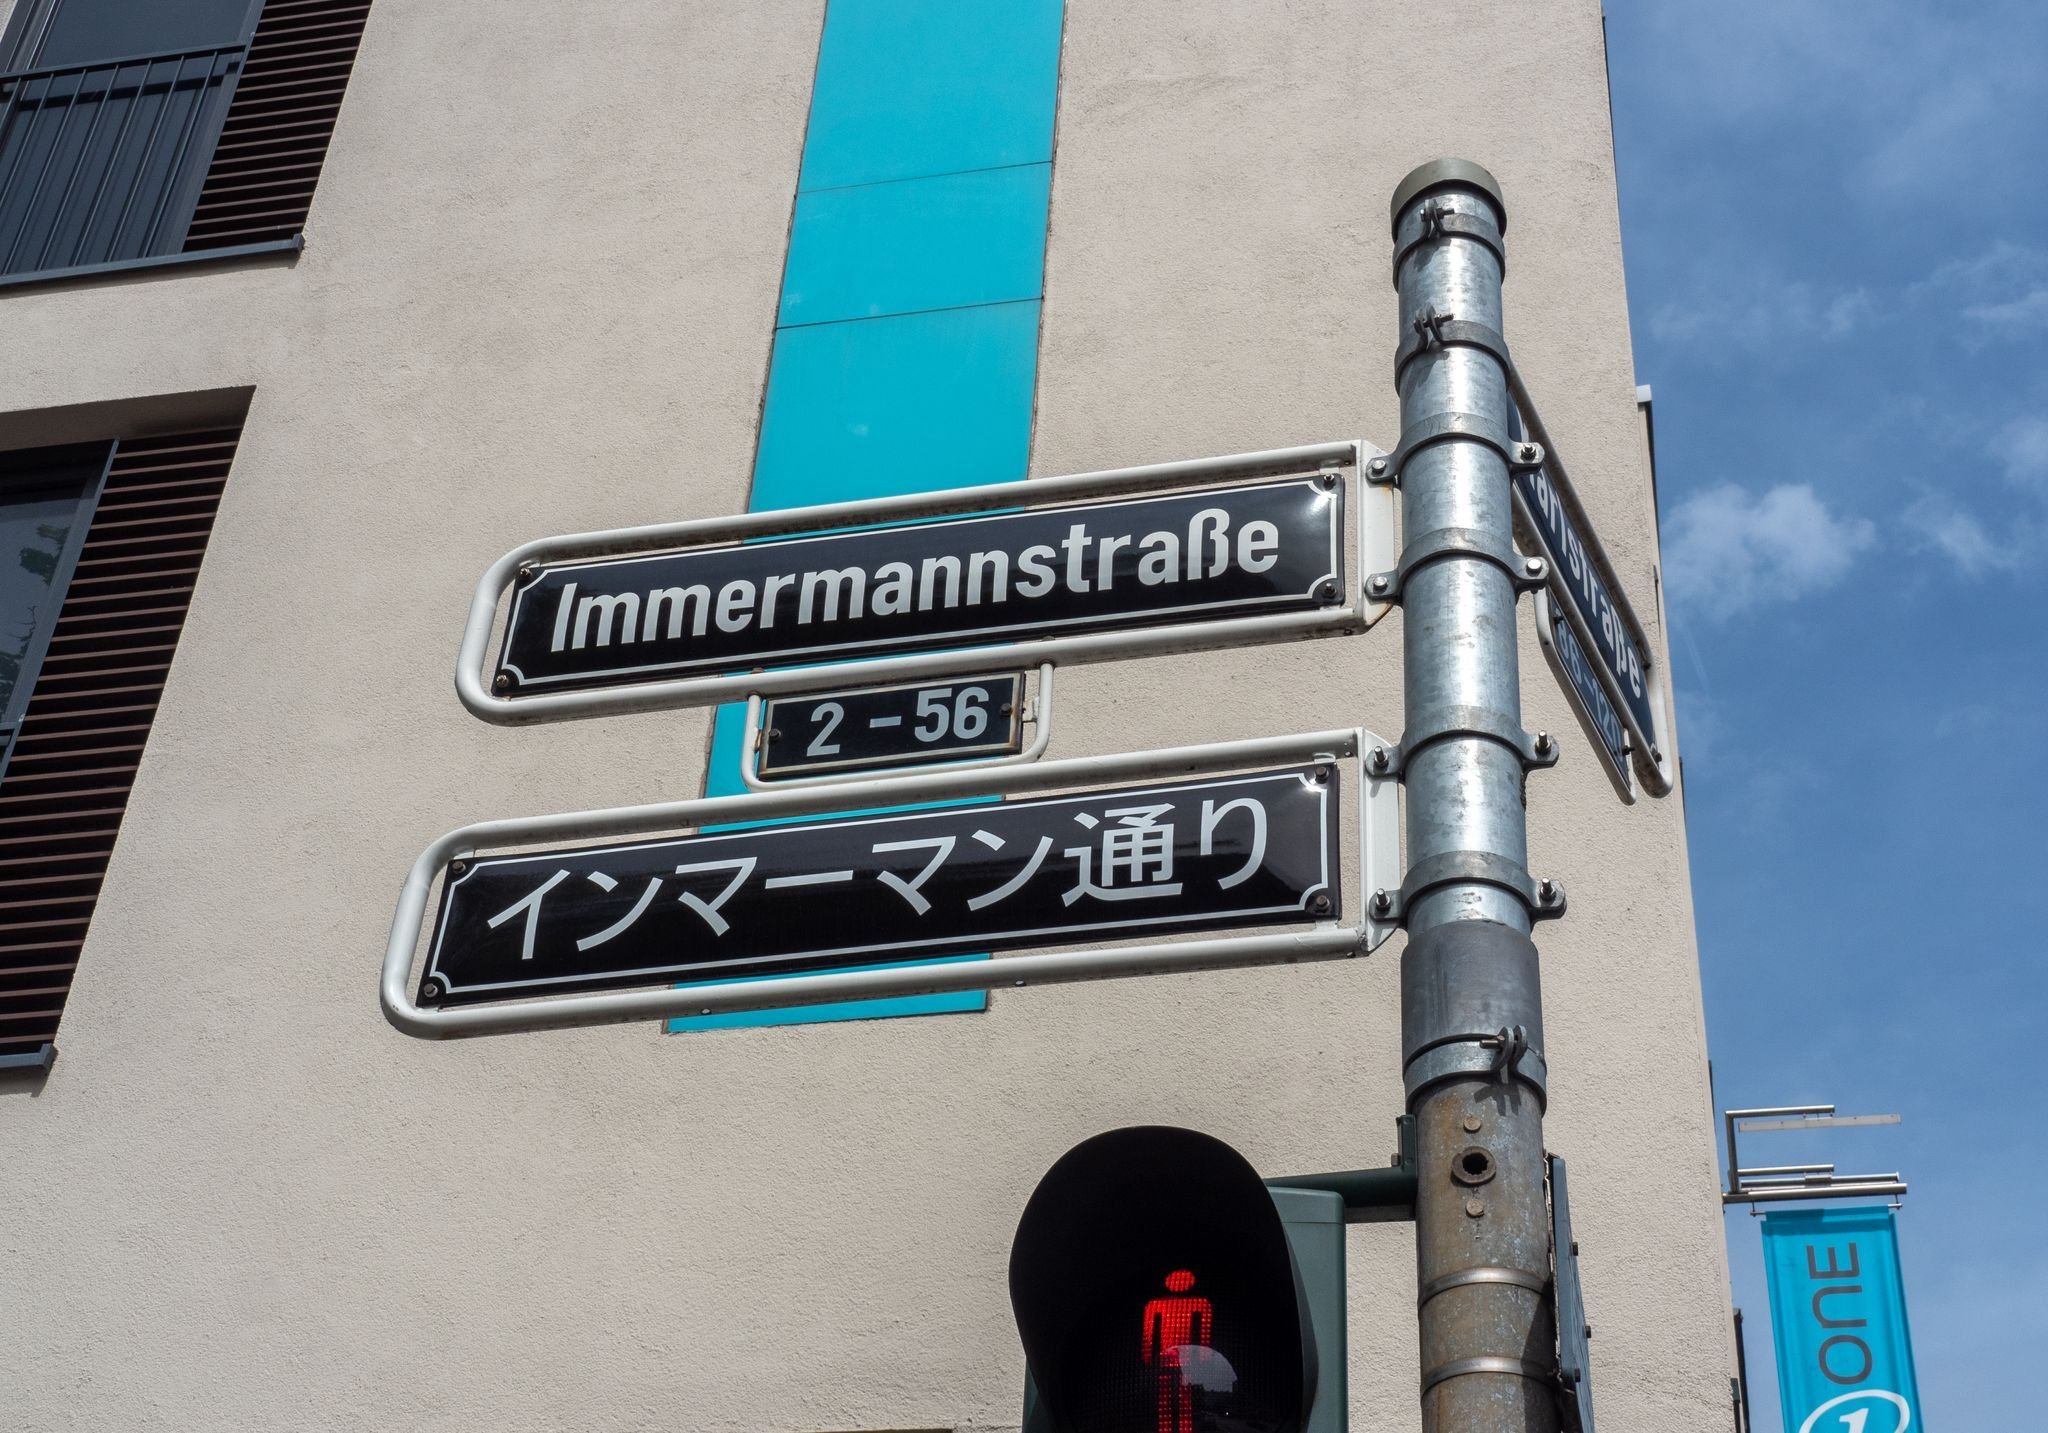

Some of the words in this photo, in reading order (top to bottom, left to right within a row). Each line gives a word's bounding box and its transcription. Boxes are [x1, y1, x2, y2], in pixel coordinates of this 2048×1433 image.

[550, 507, 1279, 652] Immermannstraße
[805, 702, 845, 757] 2
[487, 797, 1268, 960] インマーマン通り
